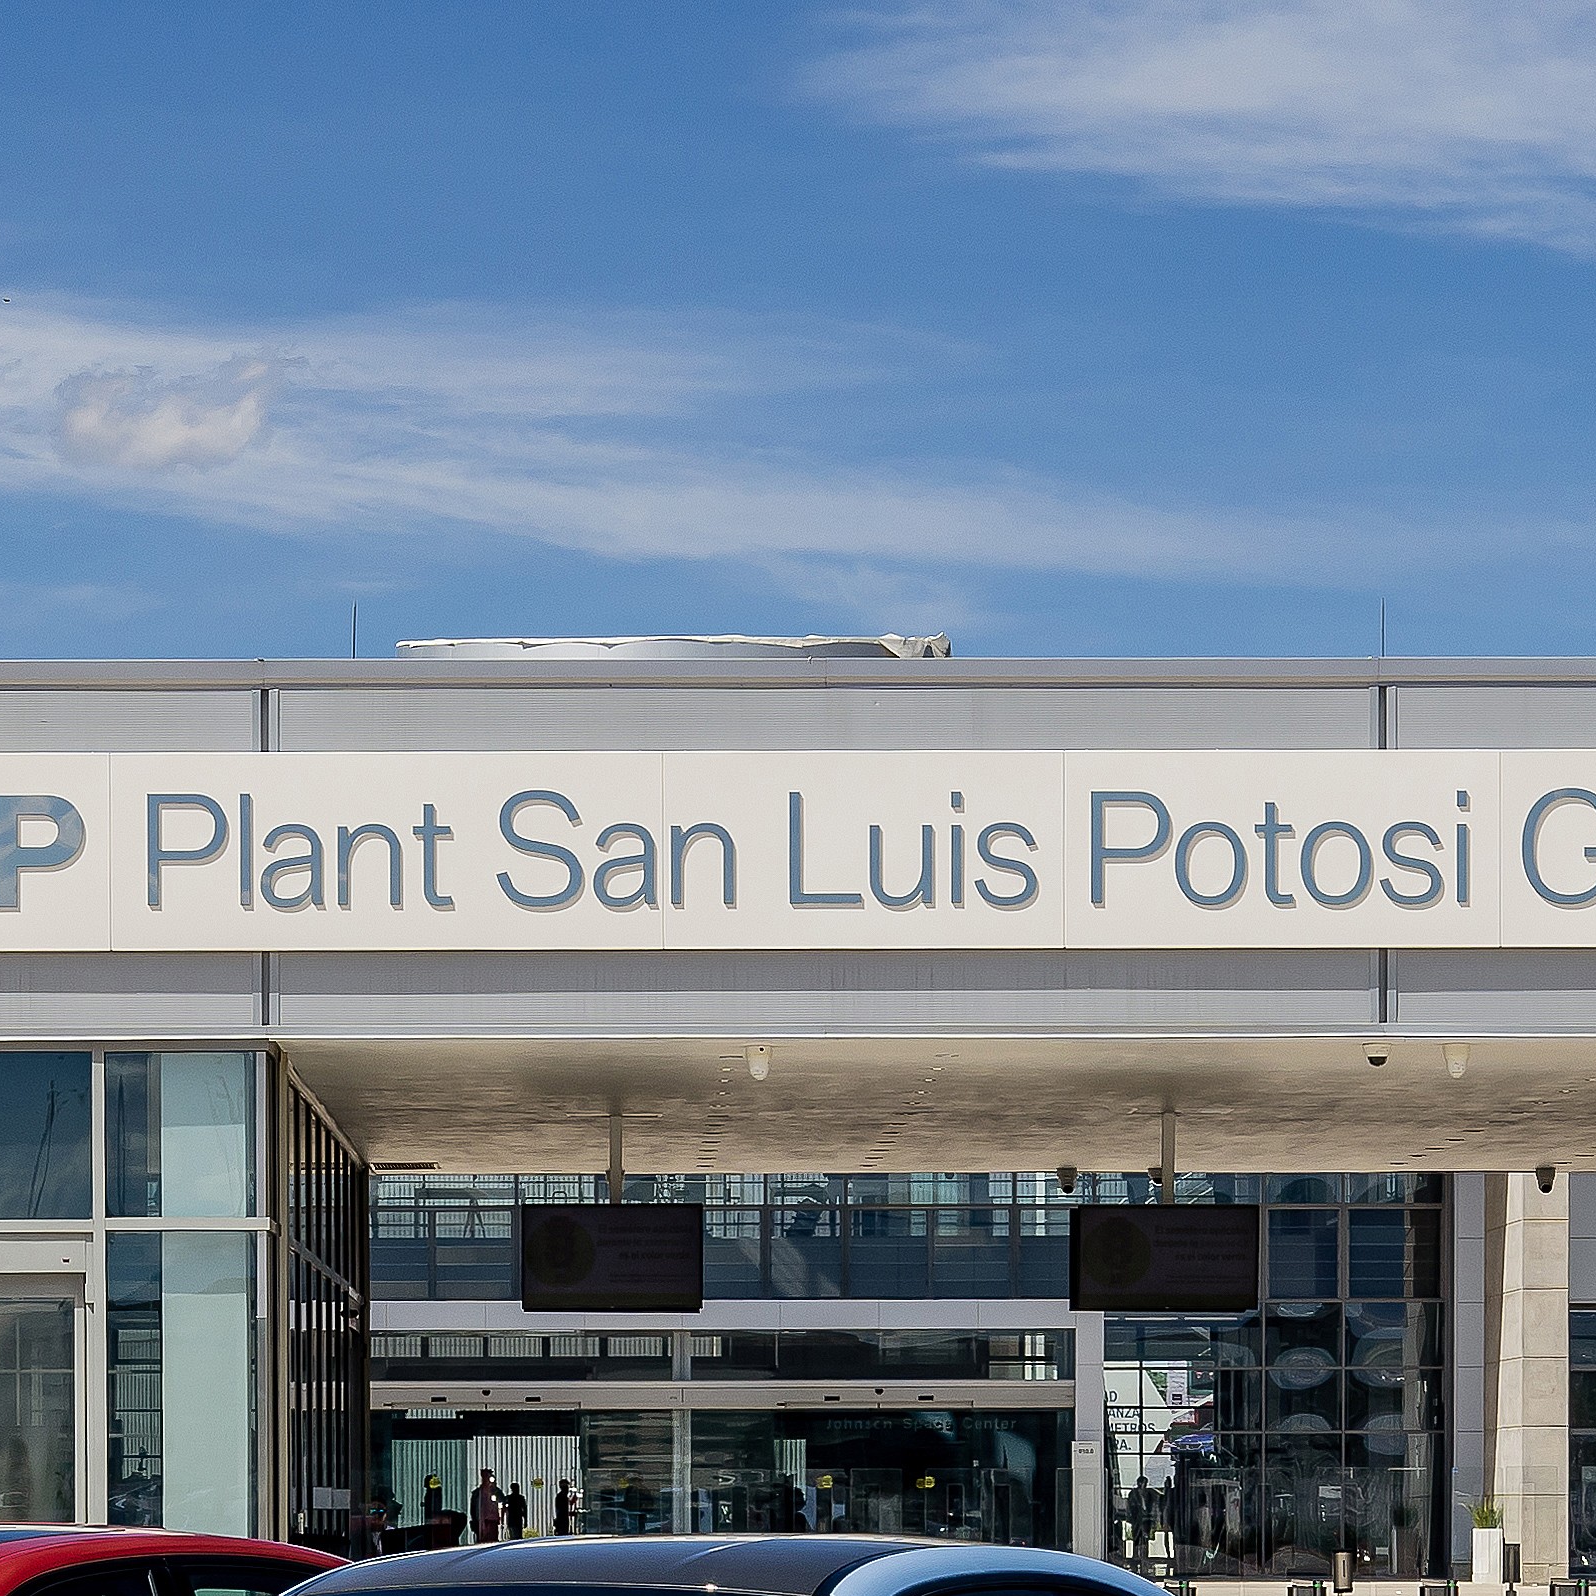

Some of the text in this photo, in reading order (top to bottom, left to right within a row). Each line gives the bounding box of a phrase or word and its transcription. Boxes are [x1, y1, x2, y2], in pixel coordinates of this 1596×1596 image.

[145, 791, 455, 912] Plant
[496, 789, 737, 912] San
[789, 791, 1040, 912] Luis
[1089, 789, 1472, 911] Potosi
[962, 1415, 1017, 1430] Center
